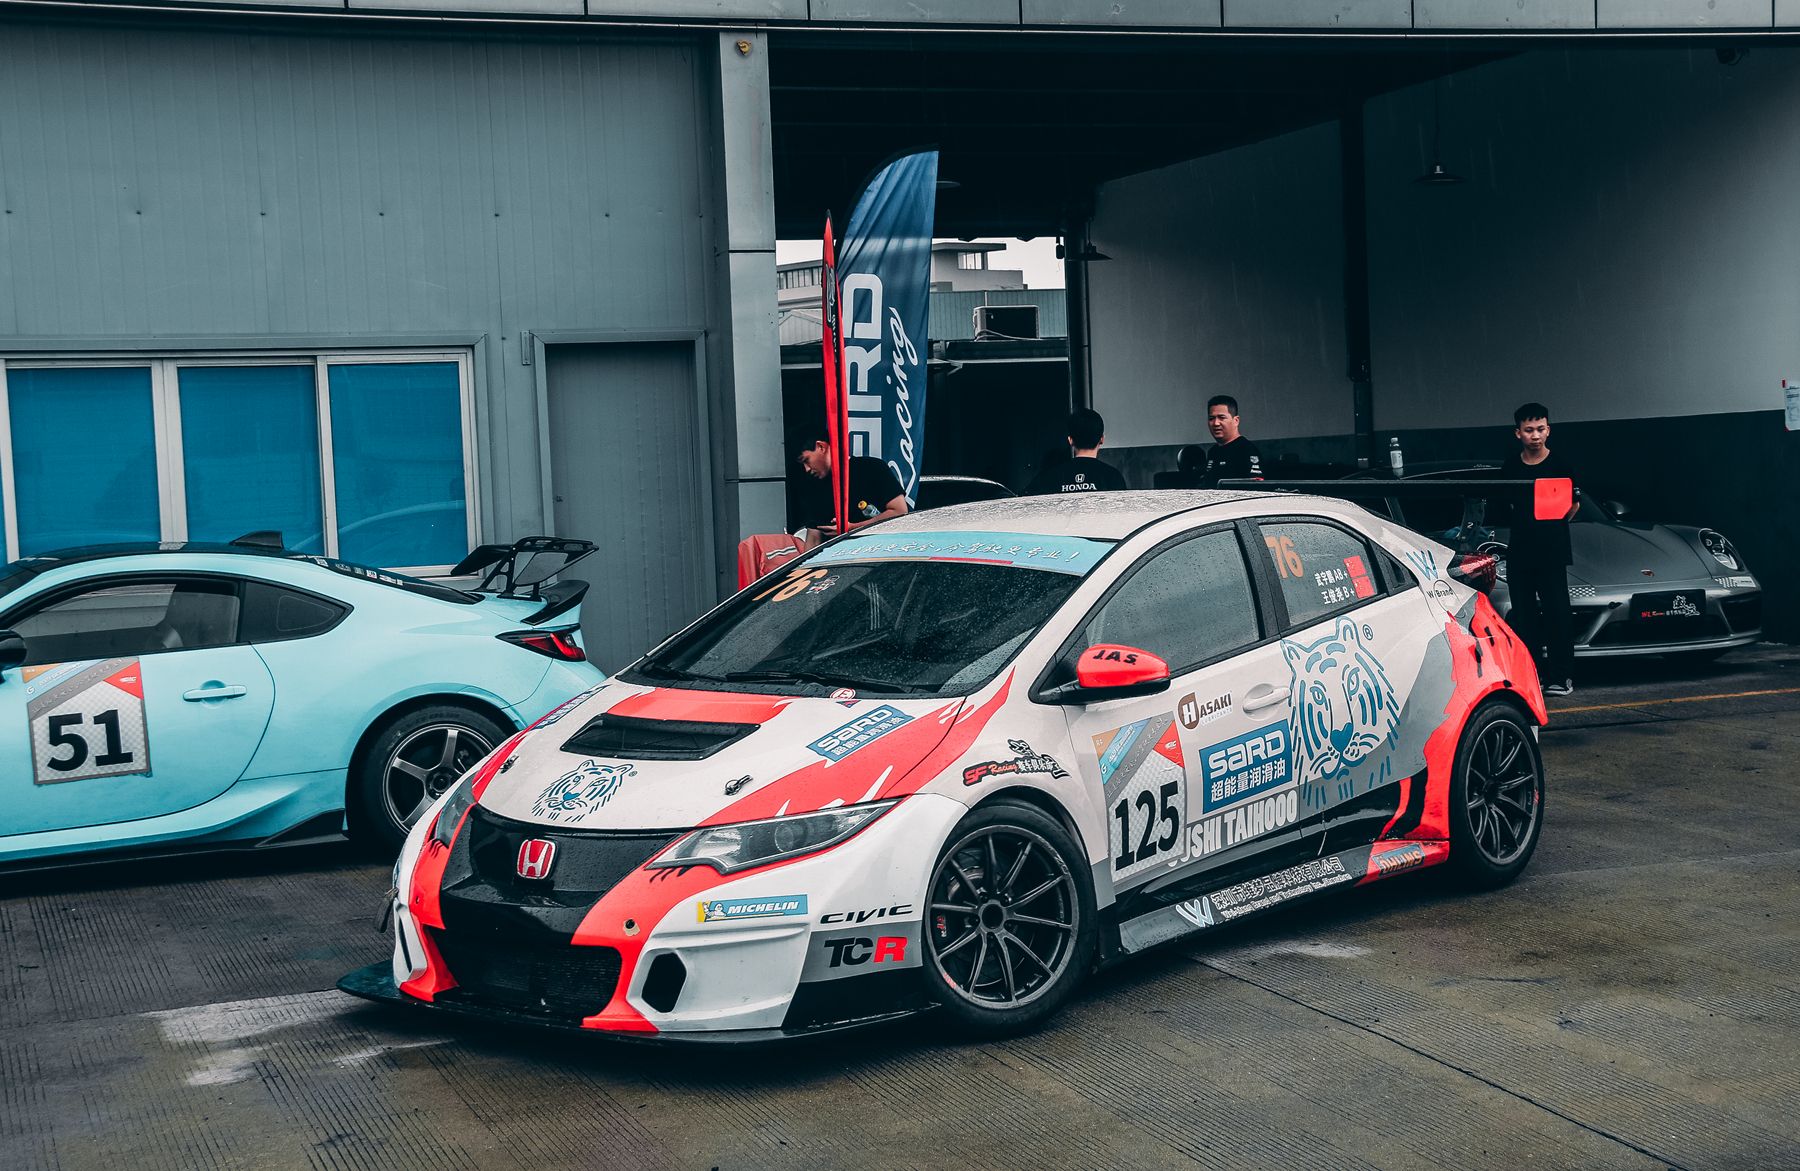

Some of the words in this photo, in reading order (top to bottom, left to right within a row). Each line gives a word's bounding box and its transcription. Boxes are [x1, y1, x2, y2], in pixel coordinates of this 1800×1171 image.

[1061, 483, 1097, 492] HONDA
[1264, 535, 1303, 578] 76
[751, 569, 828, 601] 76
[46, 709, 134, 772] 51
[964, 765, 988, 785] SF
[988, 763, 1018, 776] Racing
[1211, 757, 1286, 804] 超能量润滑油
[1115, 780, 1180, 872] 125
[1224, 789, 1298, 846] TAIHOOO
[727, 900, 799, 915] MICHELIN
[820, 903, 913, 925] CIVIC
[824, 936, 908, 968] TCR
